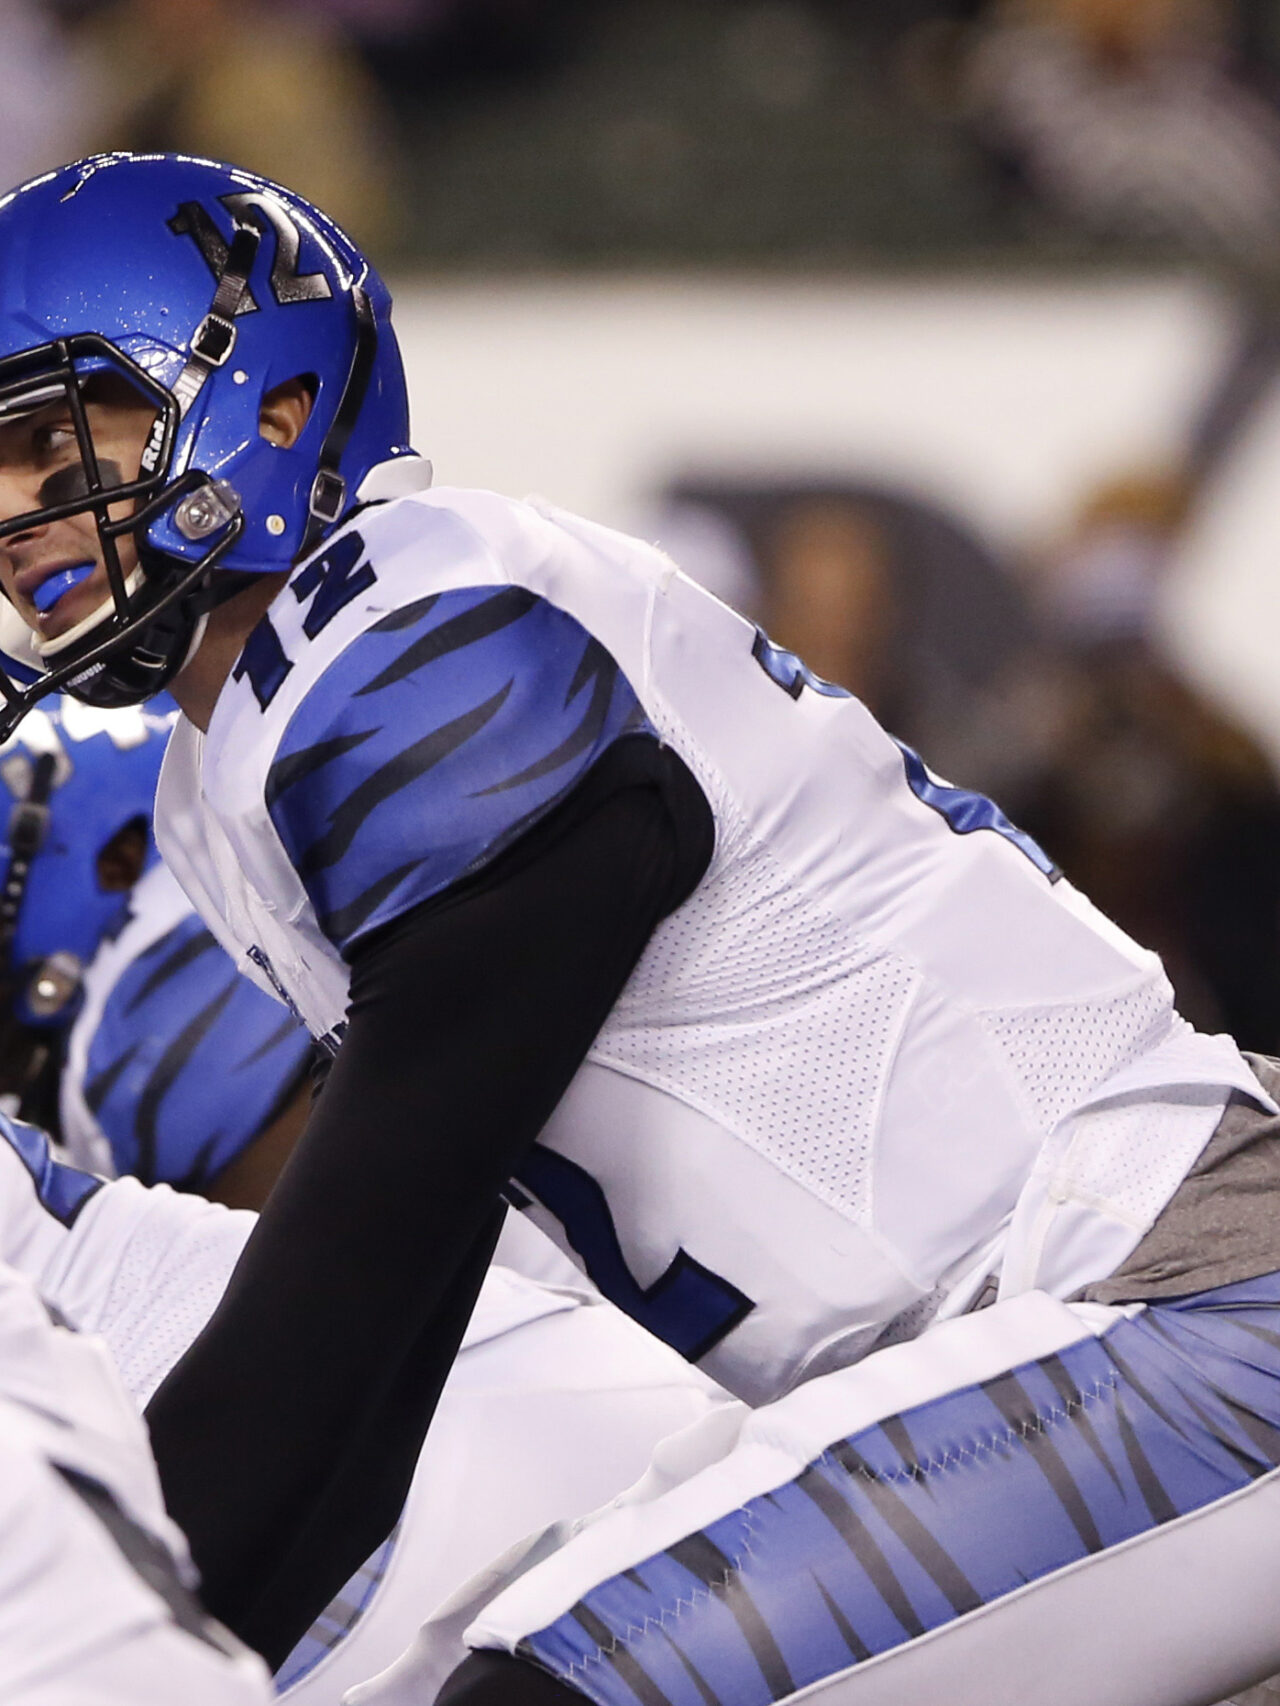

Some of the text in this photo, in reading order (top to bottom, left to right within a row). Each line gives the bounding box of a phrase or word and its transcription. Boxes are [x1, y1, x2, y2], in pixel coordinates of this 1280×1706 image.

[166, 192, 333, 318] 12
[141, 418, 166, 472] Rid
[231, 529, 379, 715] 12
